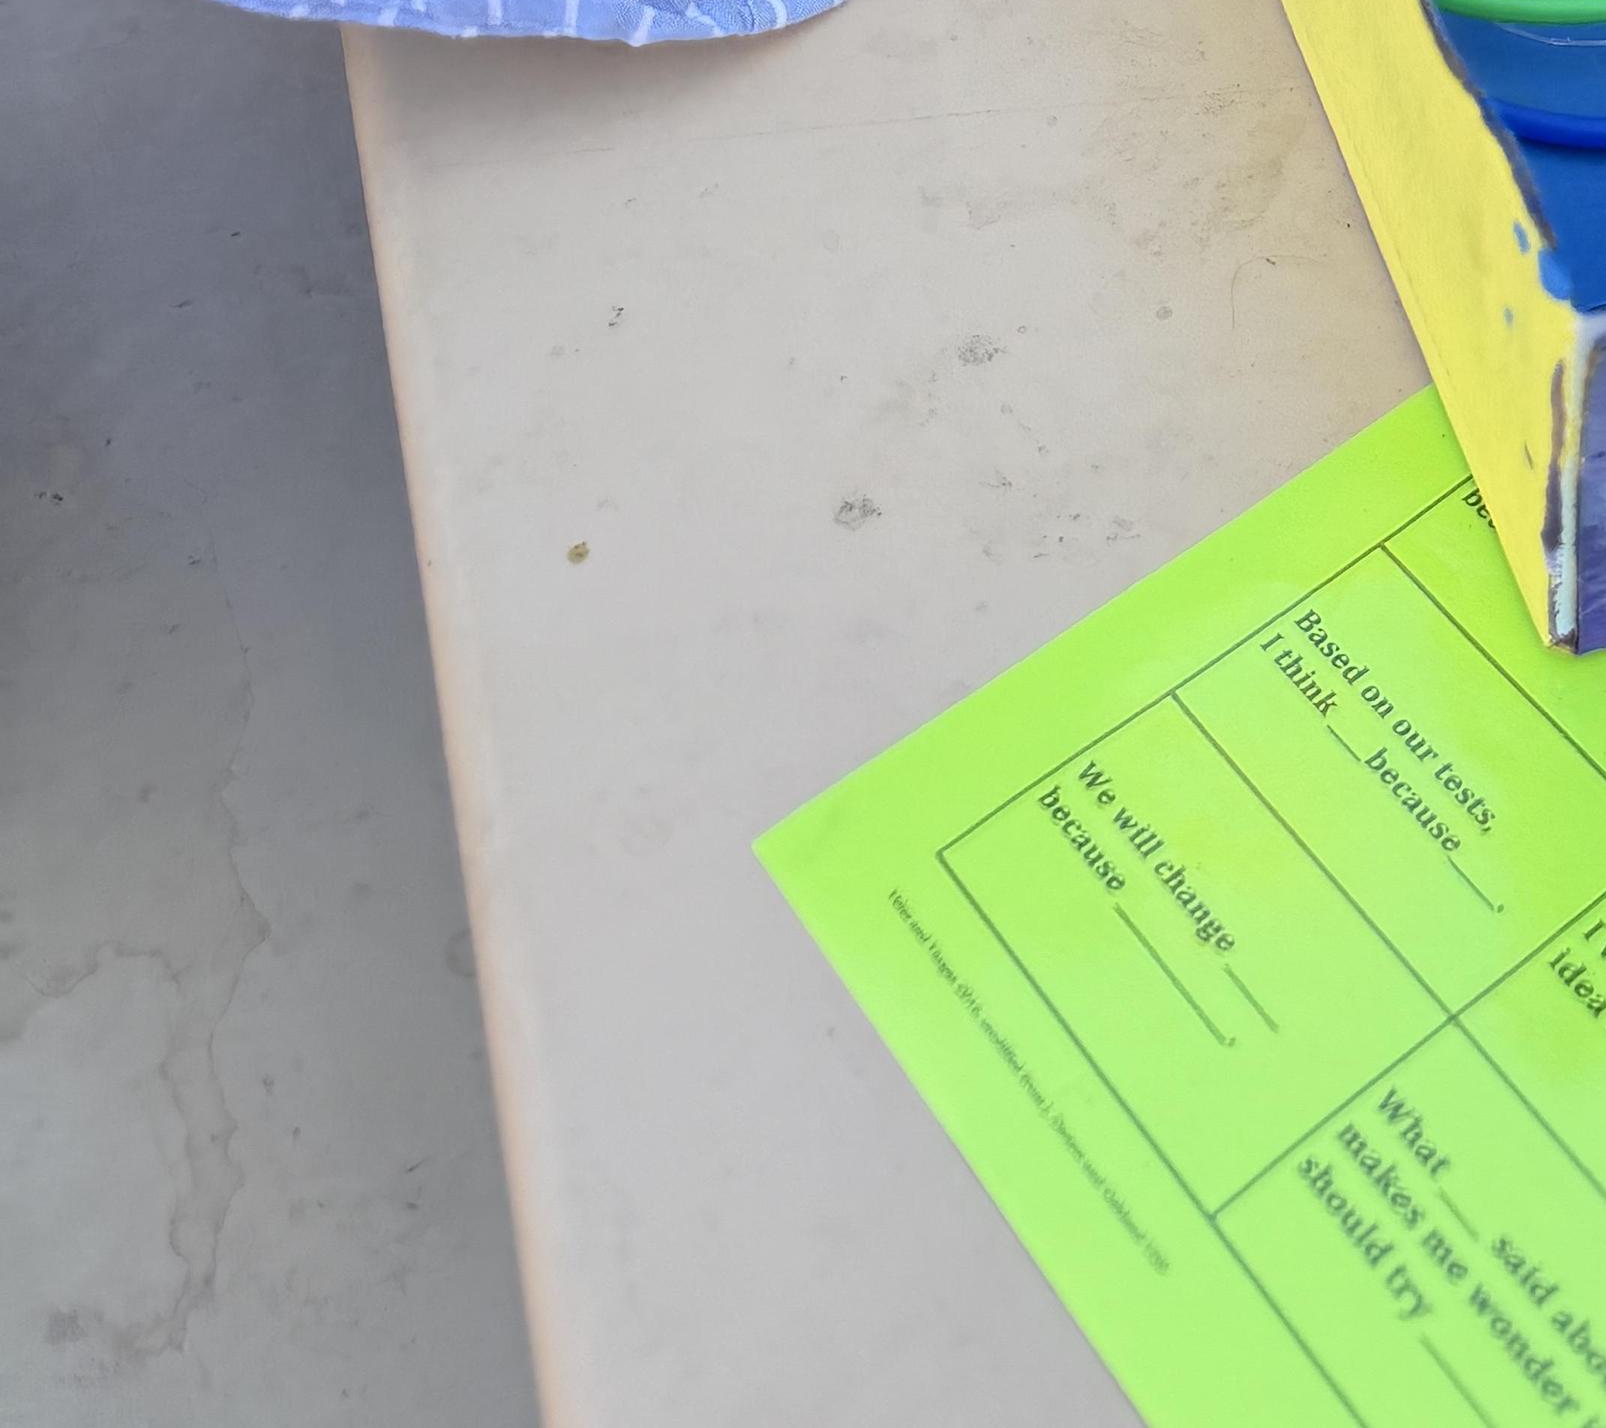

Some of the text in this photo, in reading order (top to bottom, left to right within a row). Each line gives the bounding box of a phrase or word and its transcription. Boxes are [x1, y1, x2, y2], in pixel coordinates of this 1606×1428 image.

[1258, 631, 1286, 653] I
[1272, 648, 1339, 720] think
[1292, 607, 1497, 836] Based on our tests,
[1036, 783, 1127, 892] because
[1077, 758, 1237, 953] We will change
[1296, 1156, 1434, 1322] should try
[1335, 1122, 1581, 1417] makes me wonder
[1376, 1086, 1452, 1180] What
[1490, 1236, 1561, 1310] said
